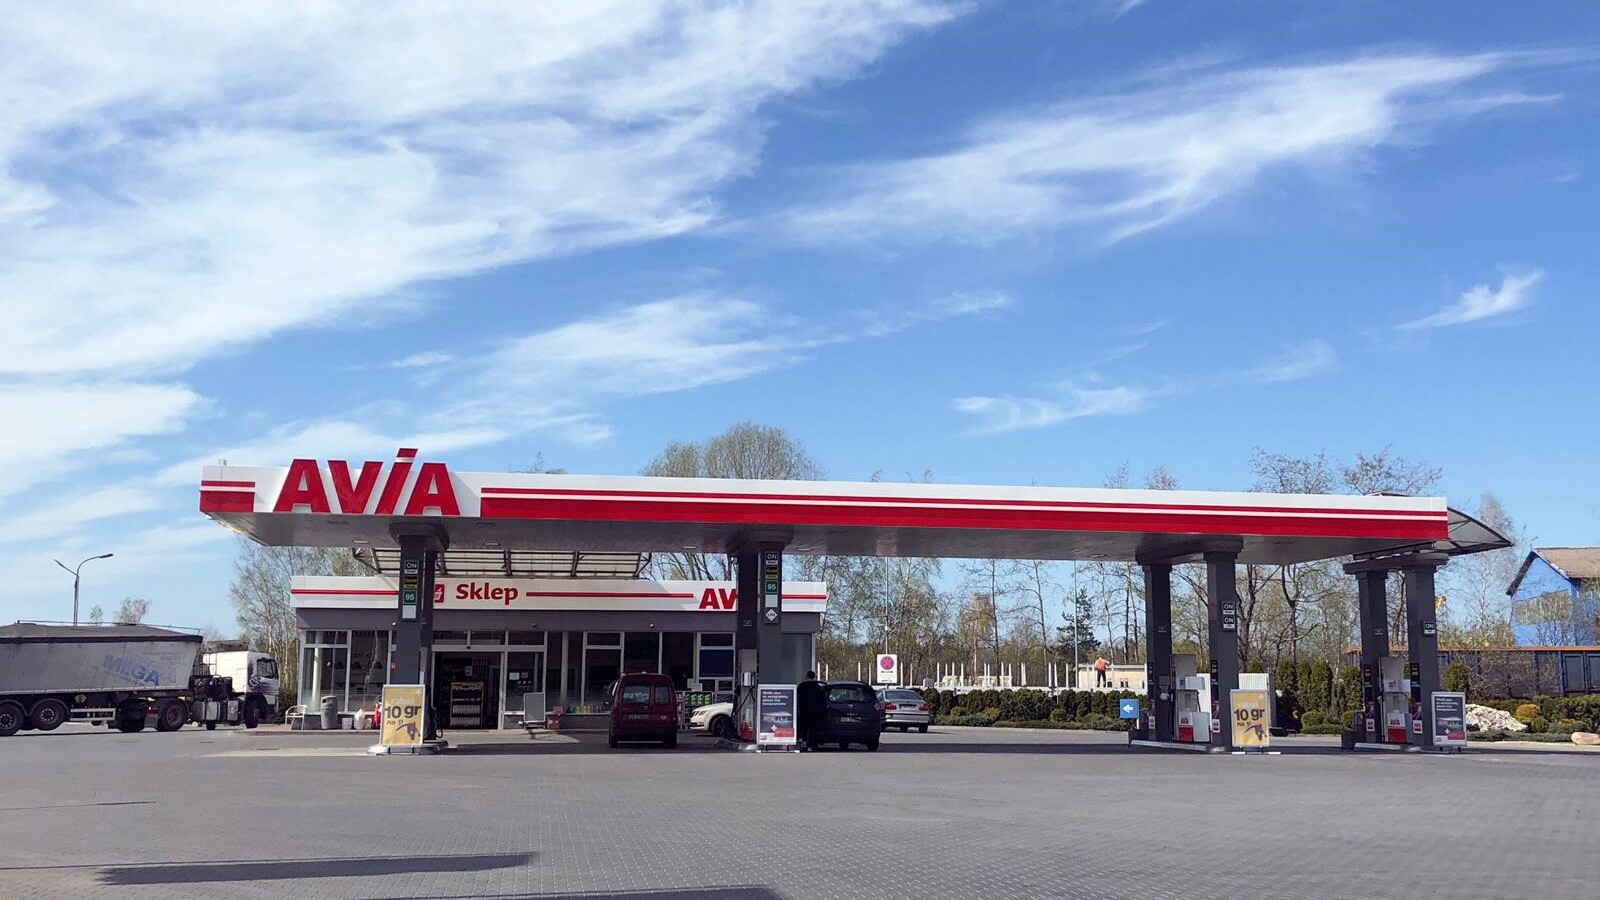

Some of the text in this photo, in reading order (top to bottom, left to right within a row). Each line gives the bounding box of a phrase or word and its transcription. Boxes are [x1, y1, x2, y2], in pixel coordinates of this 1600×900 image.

[406, 561, 417, 569] ON
[455, 582, 519, 605] Sklep
[699, 588, 737, 610] AV
[384, 705, 422, 719] 10 gr
[1233, 708, 1266, 721] 10 gr
